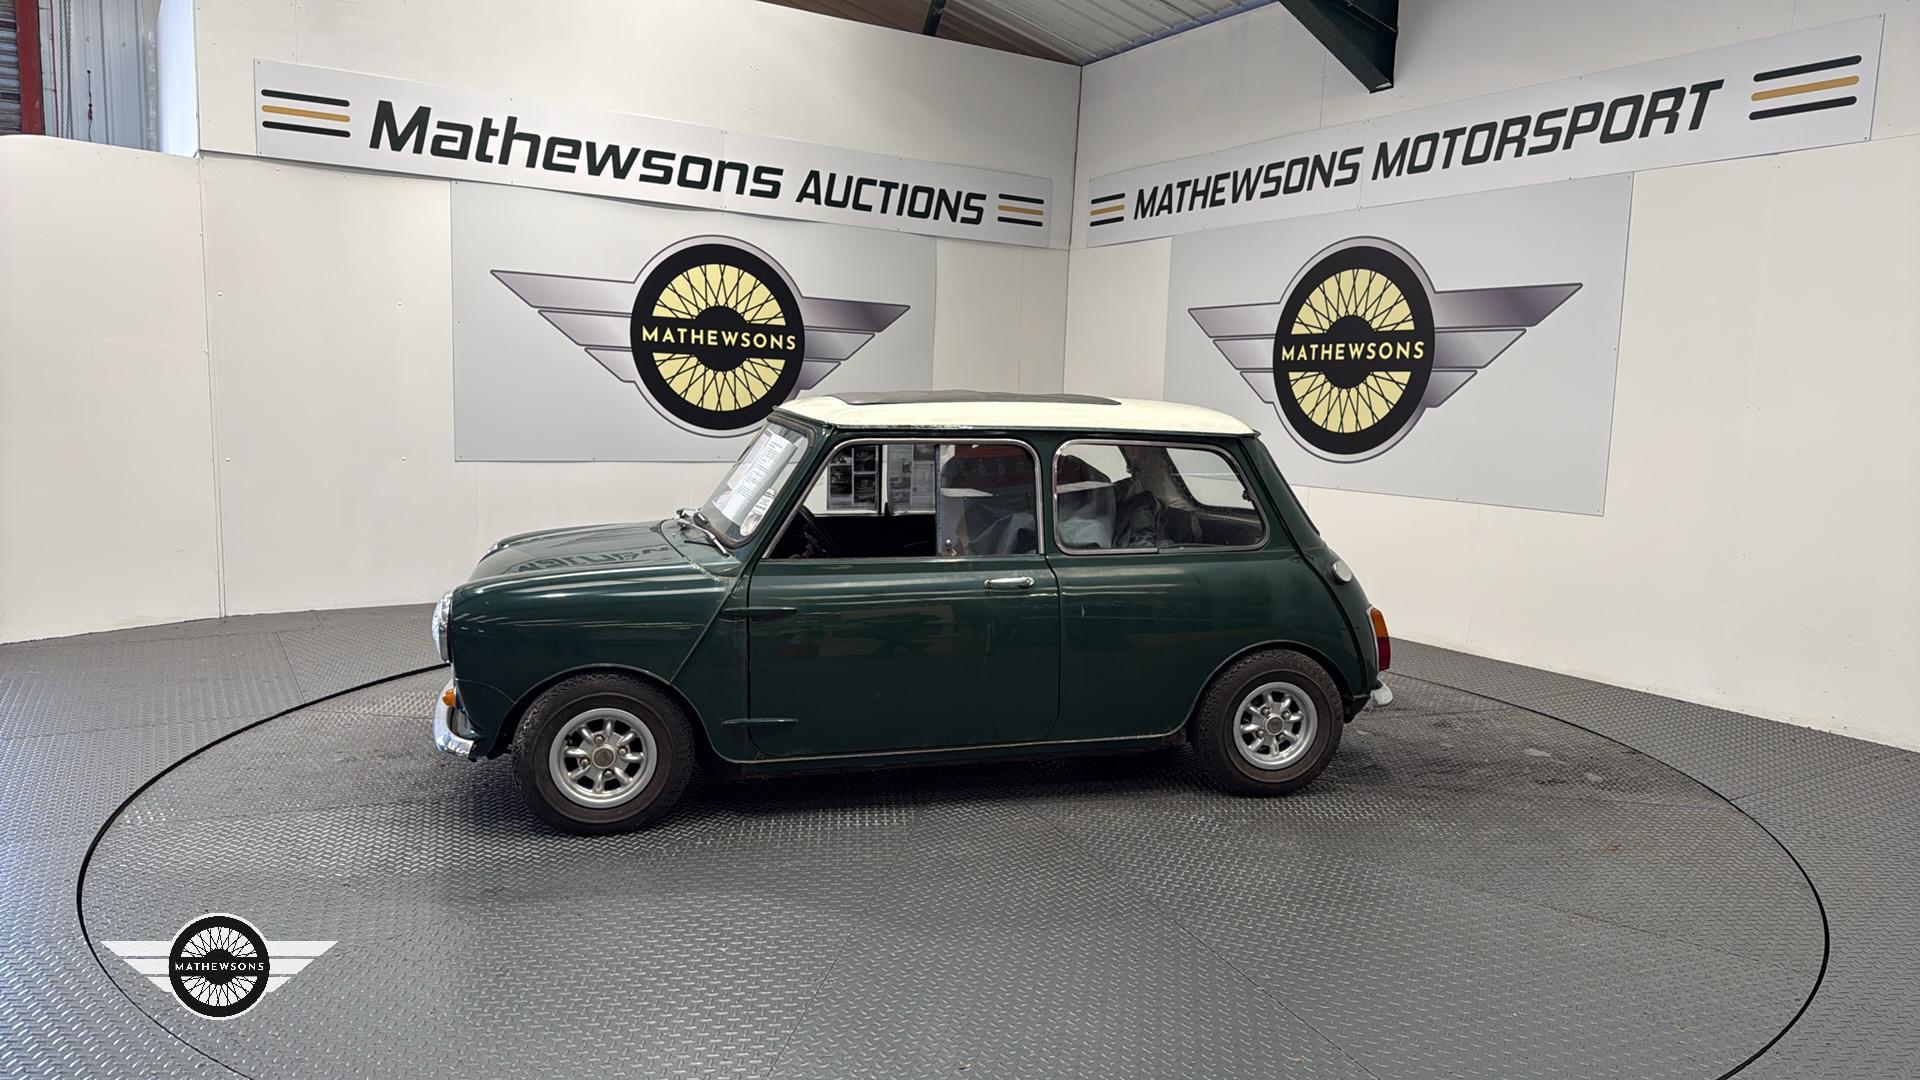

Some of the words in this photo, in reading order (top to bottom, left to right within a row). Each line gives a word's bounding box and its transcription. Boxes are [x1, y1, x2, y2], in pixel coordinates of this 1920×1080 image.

[370, 100, 784, 199] Mathewsons
[796, 170, 987, 225] AUCTIONS
[1134, 147, 1363, 220] MATHEWSONS
[1372, 79, 1724, 180] MOTORSPORT
[642, 325, 796, 350] MATHEWSONS
[1281, 341, 1425, 361] MATHEWSONS
